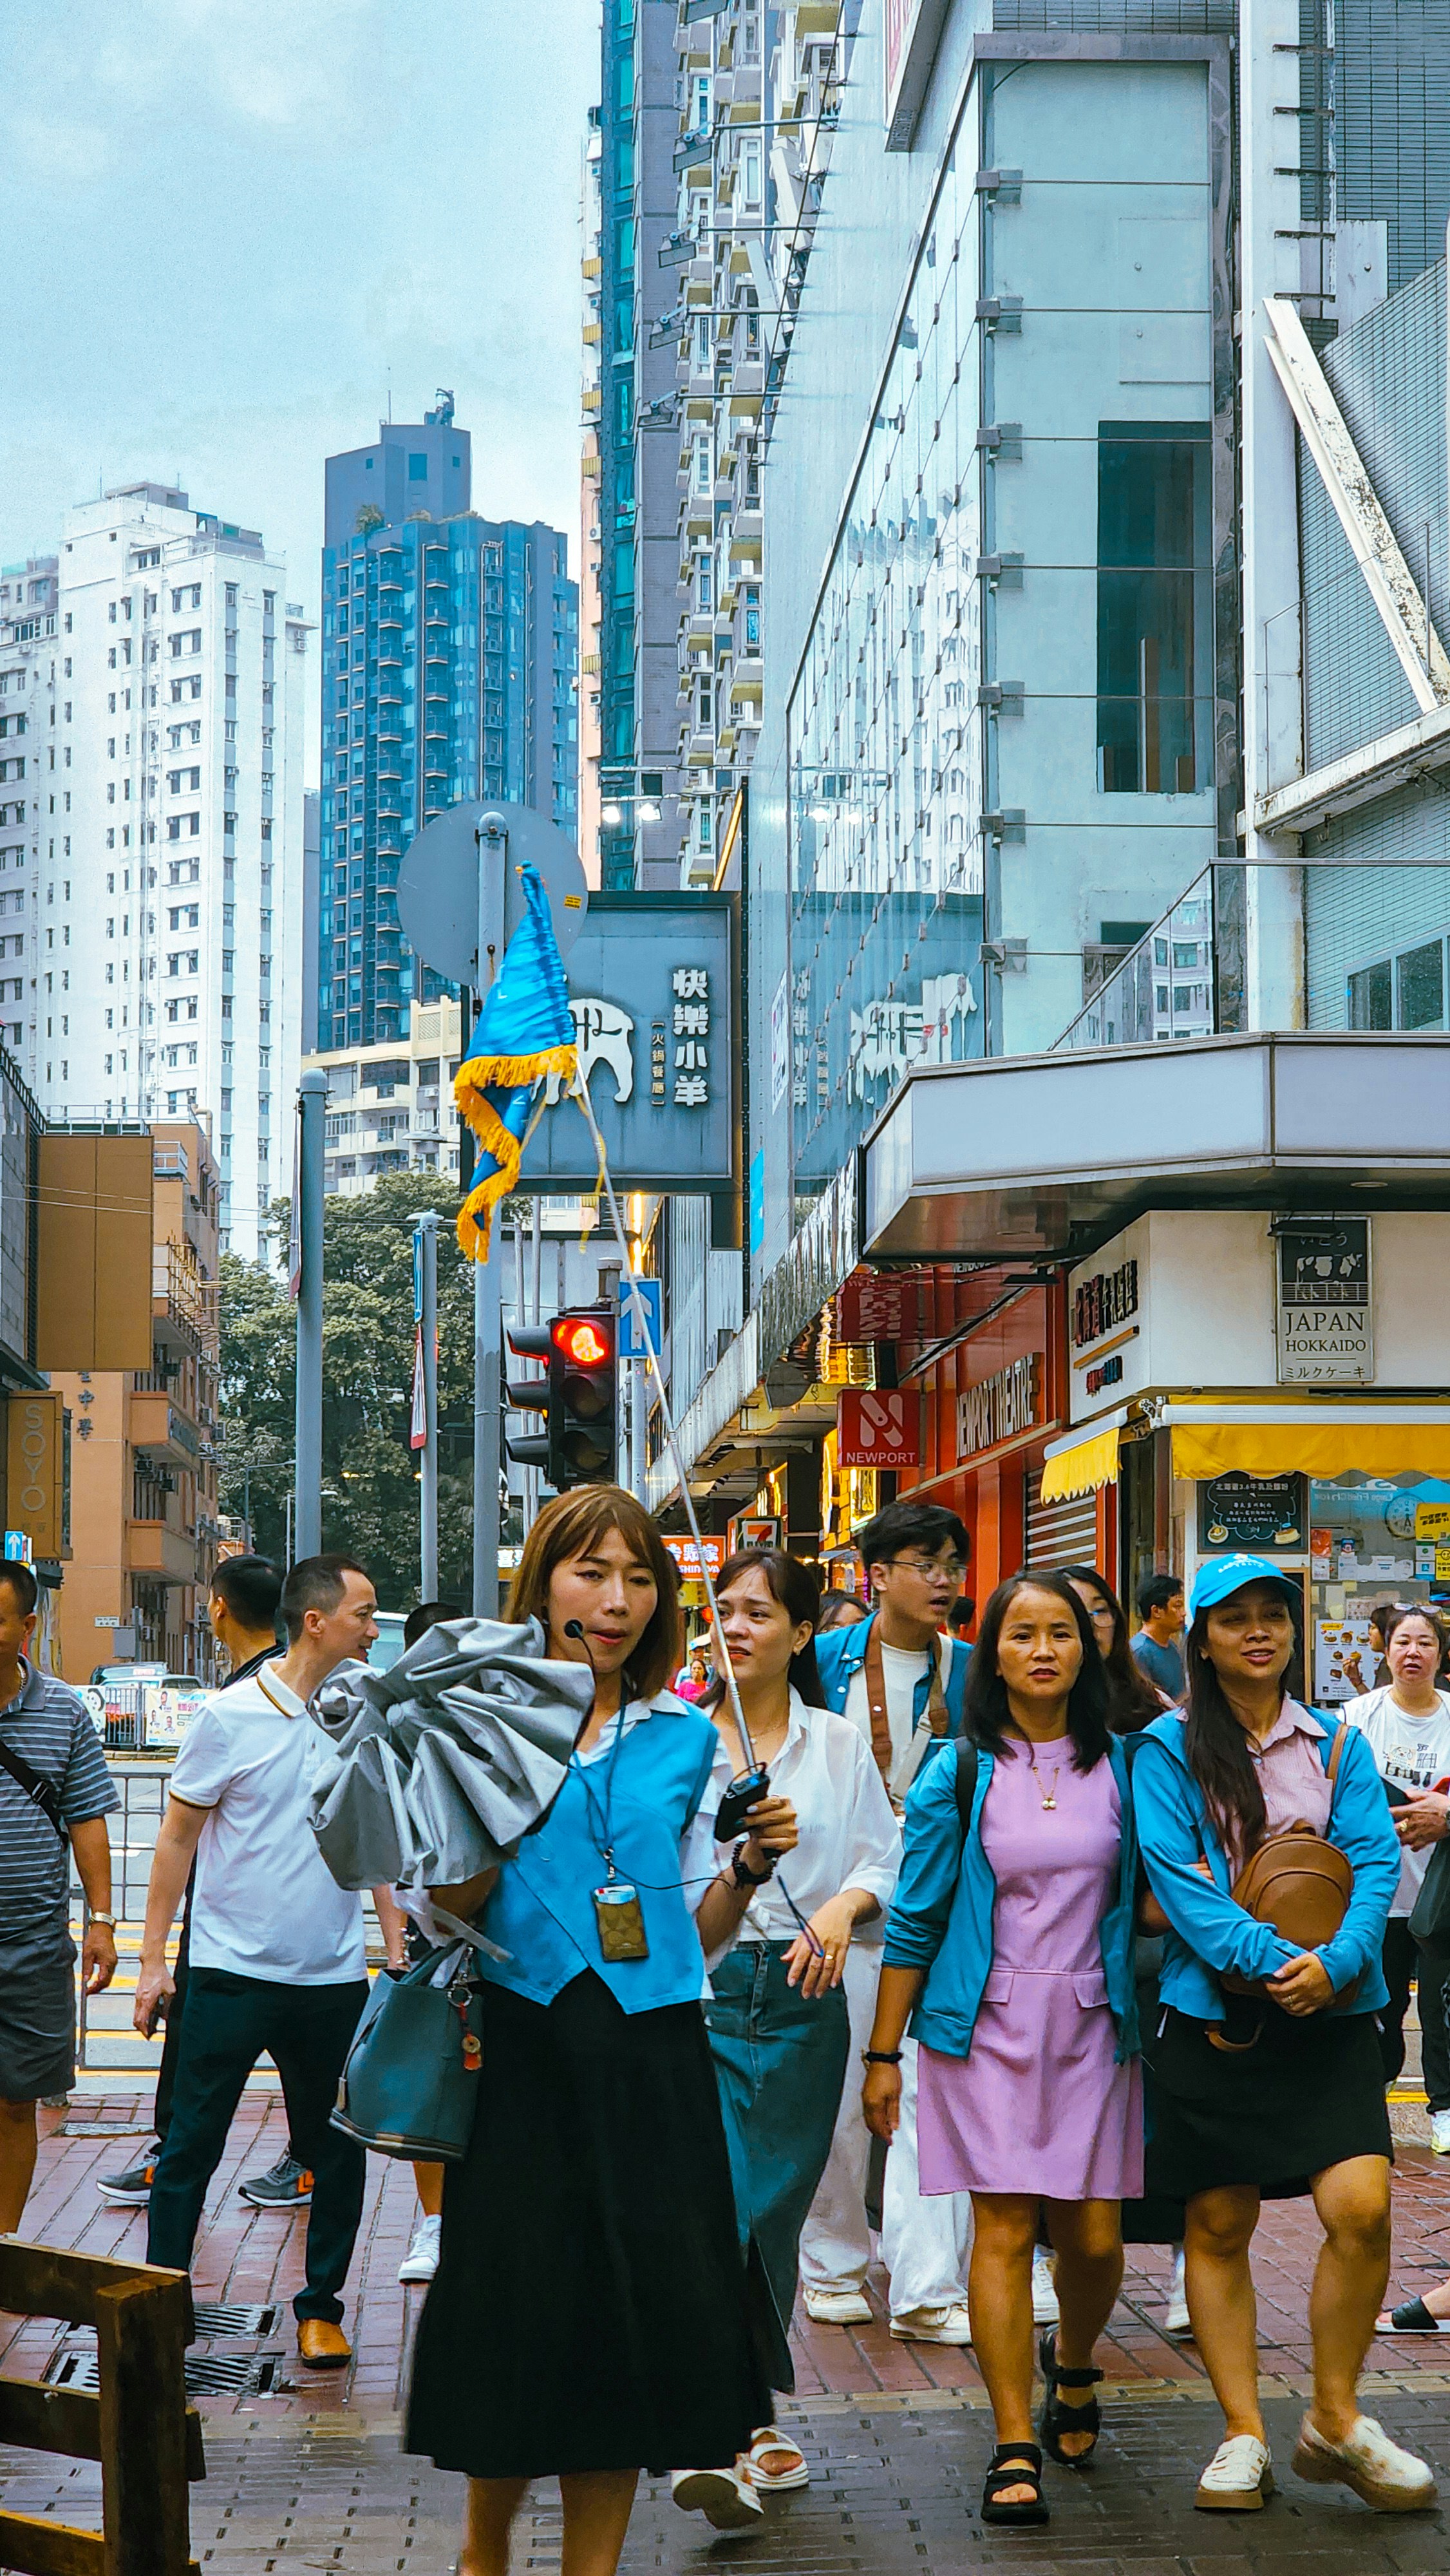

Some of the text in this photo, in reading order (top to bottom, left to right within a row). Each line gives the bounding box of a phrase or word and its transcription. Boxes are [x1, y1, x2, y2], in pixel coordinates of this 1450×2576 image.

[673, 969, 708, 1106] 快樂小羊
[1285, 1312, 1364, 1336] JAPAN
[1285, 1340, 1366, 1352] HOKKAIDO
[1285, 1366, 1366, 1379] ミルクケーキ
[995, 1353, 1033, 1440] THEATRE
[21, 1403, 46, 1512] SOYO
[846, 1452, 916, 1463] NEWPORT
